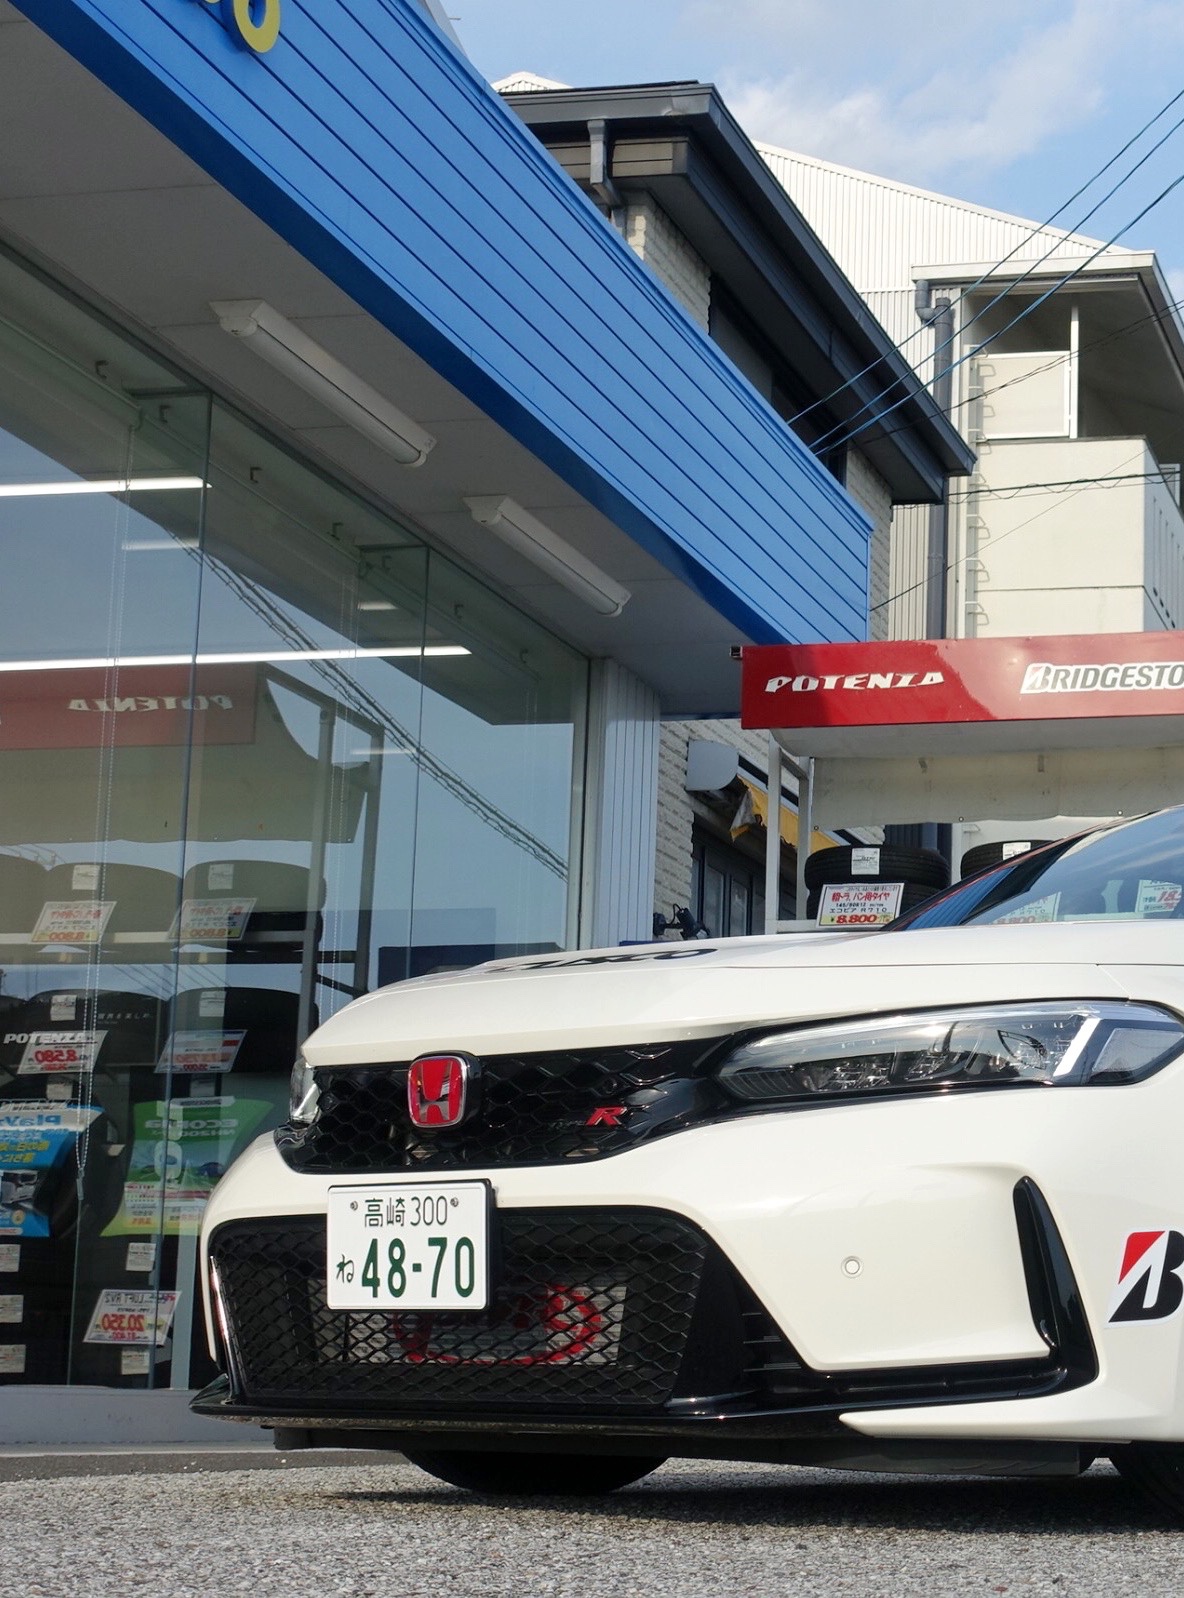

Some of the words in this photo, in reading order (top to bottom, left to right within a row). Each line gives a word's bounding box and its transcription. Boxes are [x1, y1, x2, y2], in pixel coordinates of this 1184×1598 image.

[765, 672, 945, 693] POTENZA
[336, 1253, 355, 1284] ね
[361, 1236, 475, 1298] 48-70
